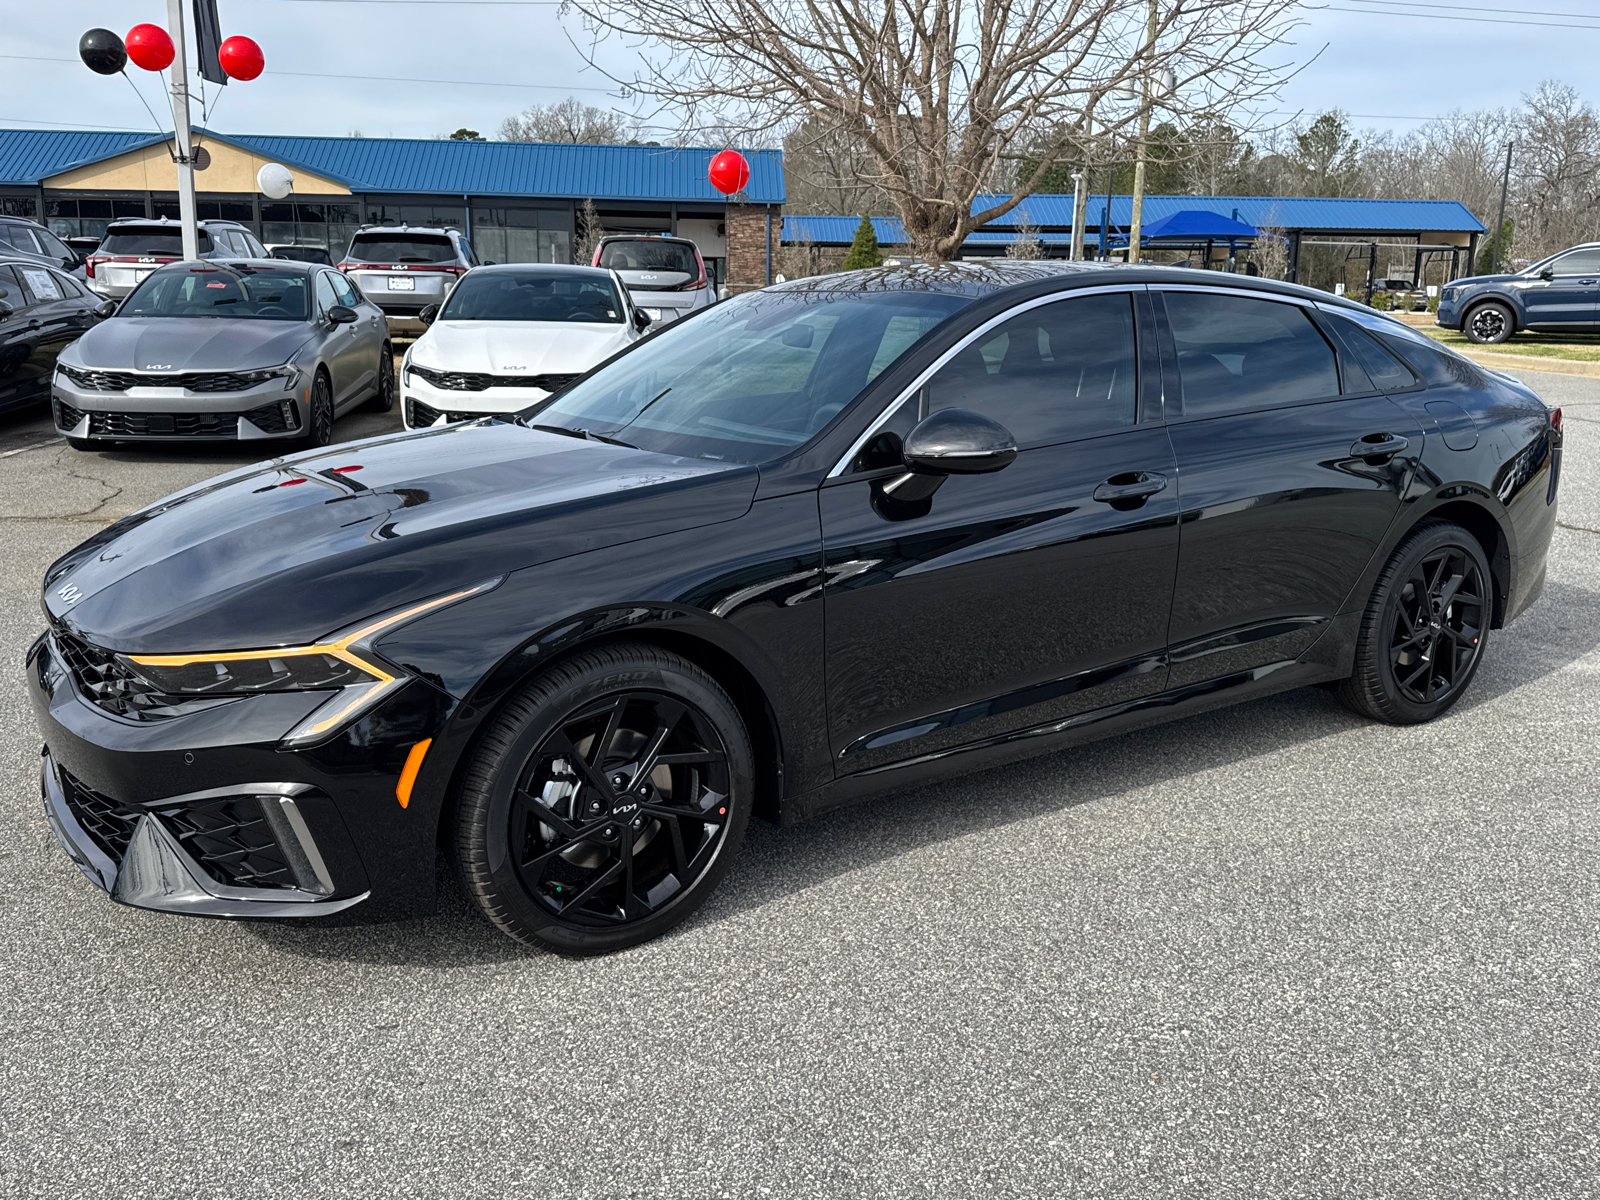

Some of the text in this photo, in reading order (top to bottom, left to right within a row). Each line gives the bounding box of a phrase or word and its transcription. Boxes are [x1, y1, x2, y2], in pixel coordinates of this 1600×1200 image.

[57, 582, 84, 606] KIA
[587, 671, 649, 692] ZERO
[612, 802, 637, 815] KIA
